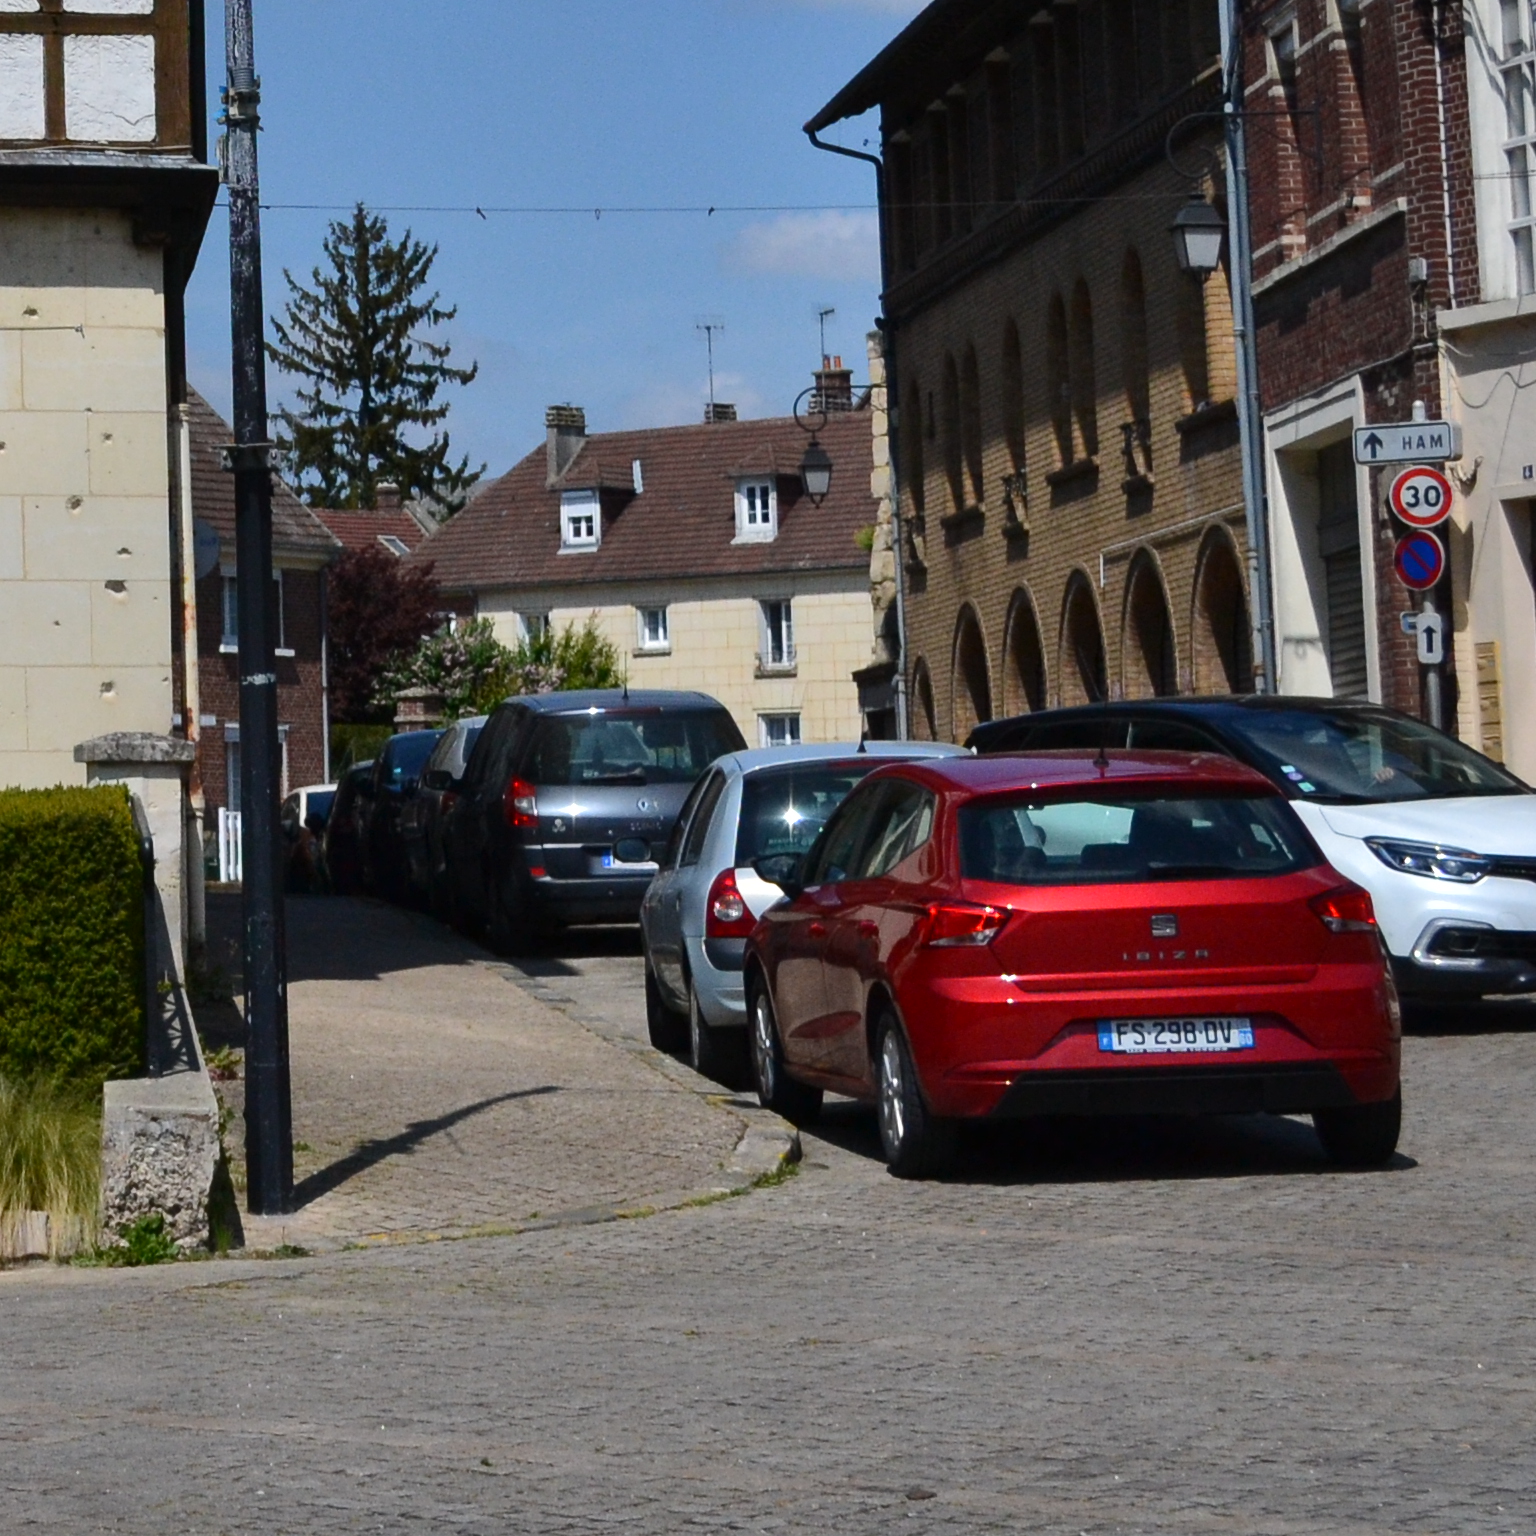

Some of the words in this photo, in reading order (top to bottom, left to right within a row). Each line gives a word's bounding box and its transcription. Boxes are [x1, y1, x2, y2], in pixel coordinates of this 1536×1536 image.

[1402, 434, 1443, 450] HAM
[1405, 485, 1441, 508] 30
[1123, 949, 1209, 960] IBIZA
